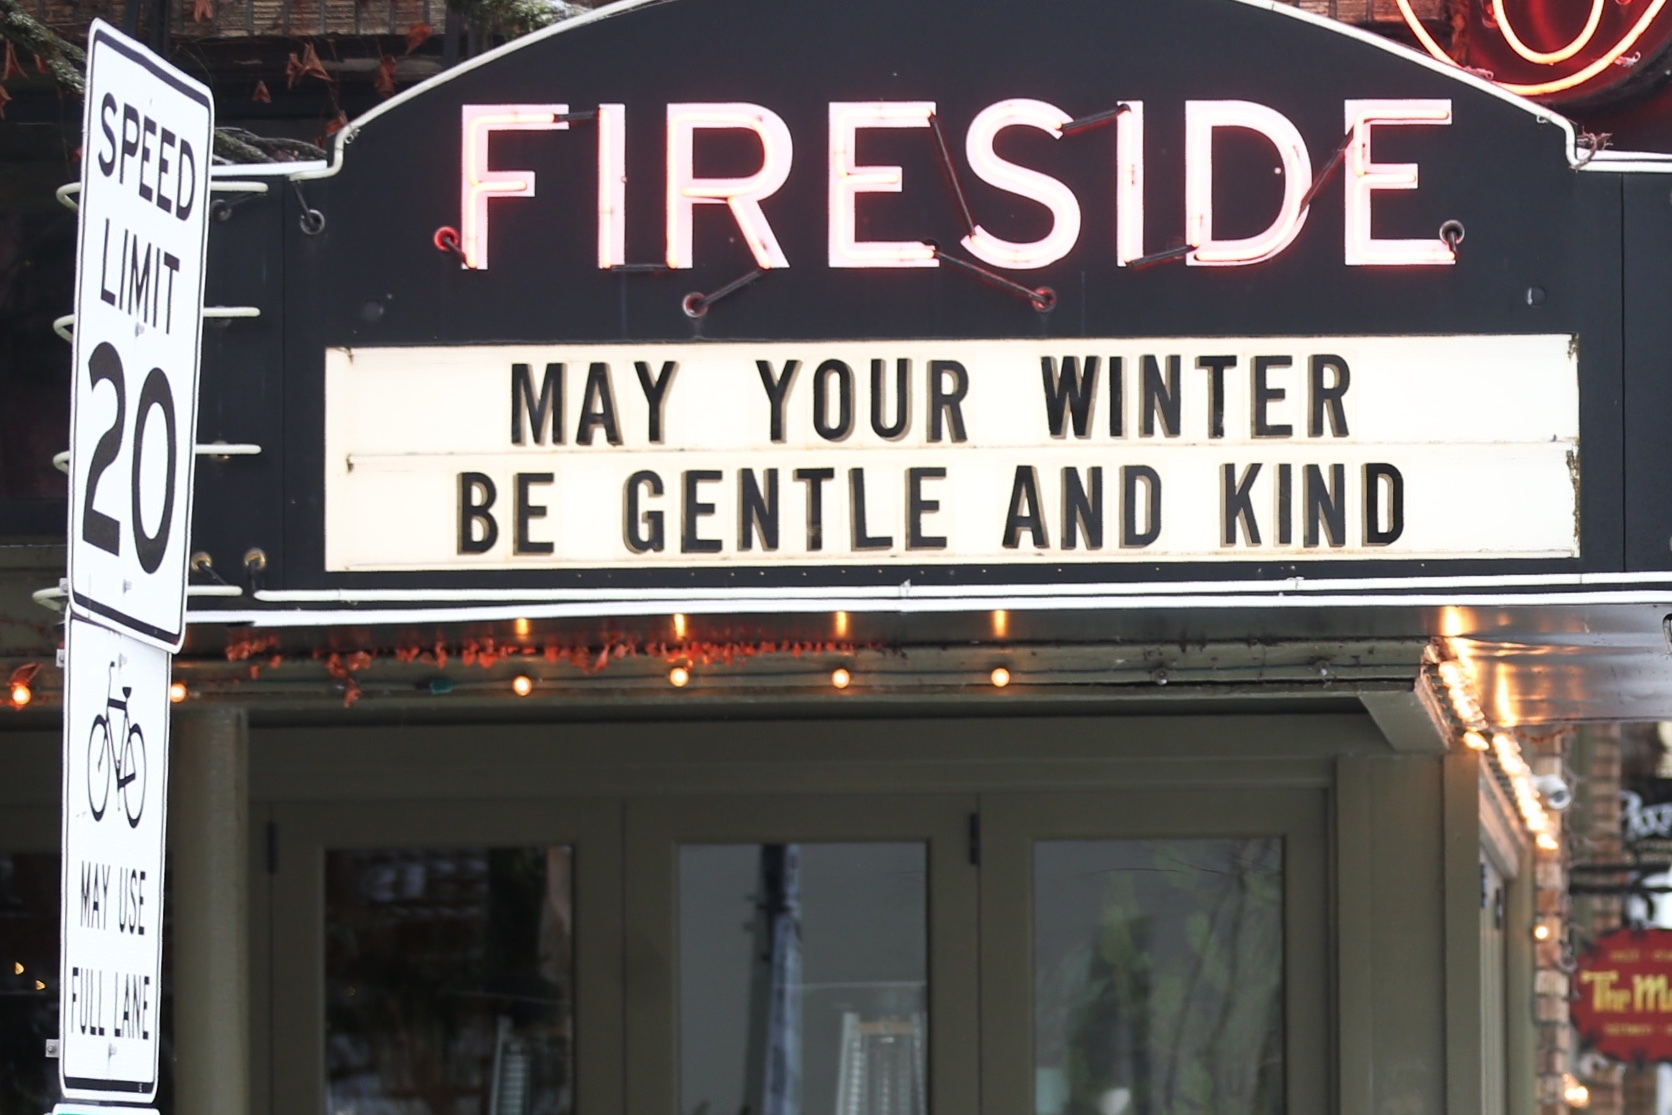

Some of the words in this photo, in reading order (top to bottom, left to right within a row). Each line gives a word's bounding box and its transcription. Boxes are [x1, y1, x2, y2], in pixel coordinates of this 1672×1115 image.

[98, 92, 196, 221] SPEED
[461, 98, 1457, 270] FIRESIDE
[100, 217, 181, 335] LIMIT
[510, 360, 679, 446] MAY
[755, 358, 969, 443] YOUR
[1040, 354, 1352, 440] WINTER
[82, 341, 176, 575] 20
[456, 471, 556, 555] BE
[622, 466, 948, 552] GENTLE
[1002, 463, 1162, 550] AND
[1219, 462, 1404, 548] KIND
[80, 860, 111, 931] MAY
[118, 866, 147, 936] USE
[71, 966, 105, 1037] FULL
[114, 971, 150, 1041] LANE
